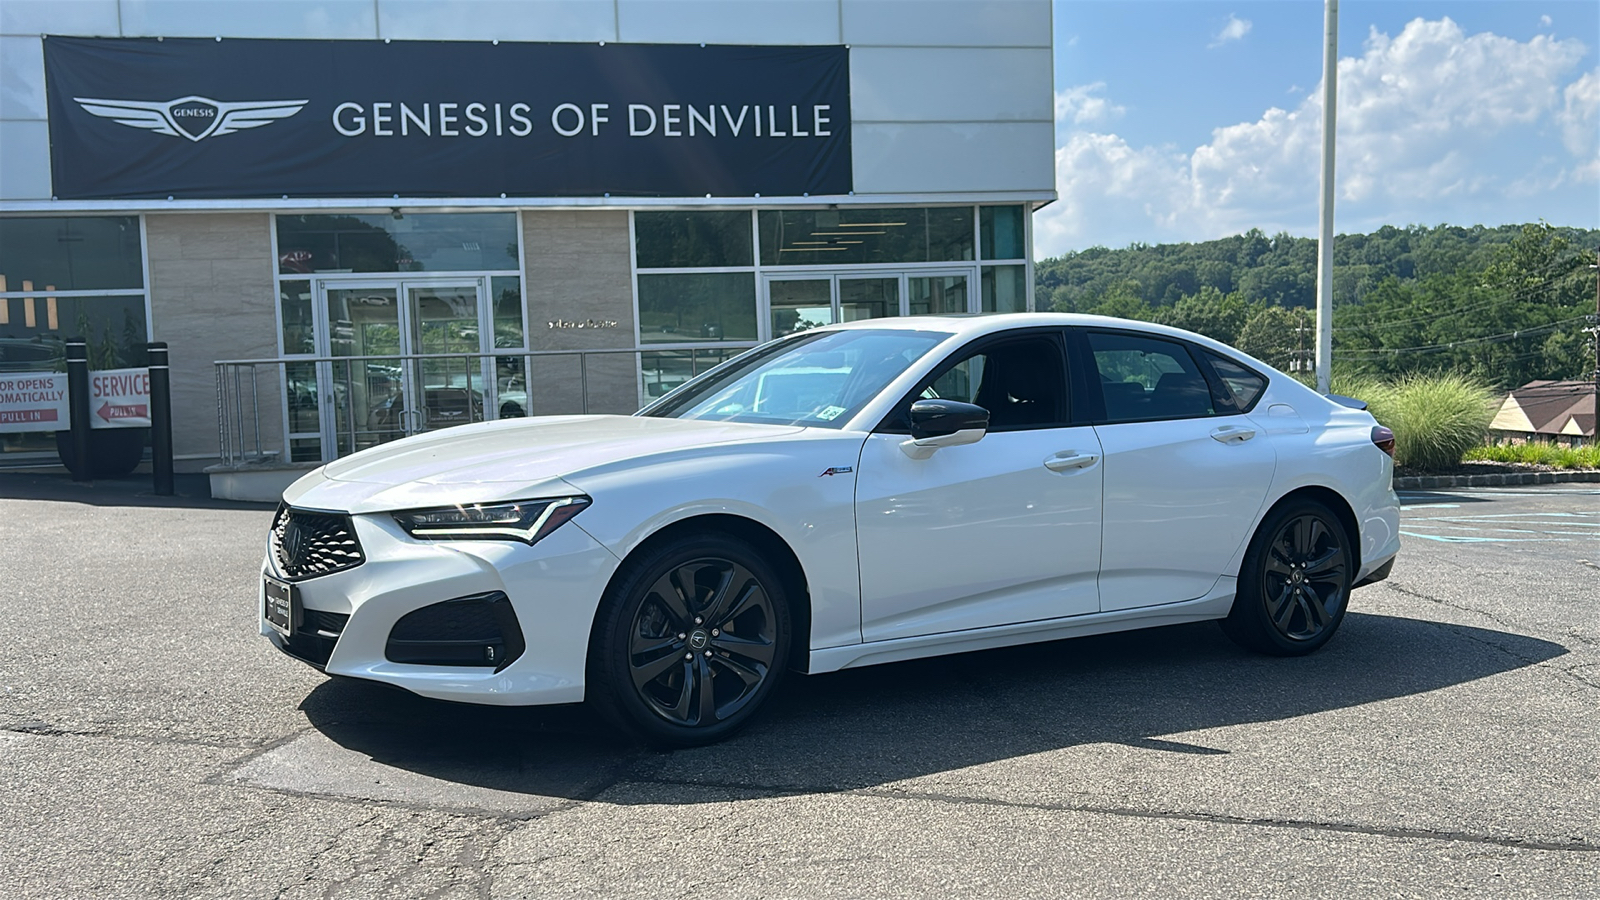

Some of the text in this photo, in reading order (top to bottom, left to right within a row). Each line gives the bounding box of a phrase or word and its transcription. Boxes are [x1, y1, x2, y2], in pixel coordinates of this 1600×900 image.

[173, 108, 214, 117] GENESIS
[332, 102, 831, 137] GENESIS OF DENVILLE
[17, 378, 54, 390] OPENS
[93, 373, 150, 398] SERVICE
[1, 411, 41, 422] PULL IN
[110, 407, 127, 417] PULL
